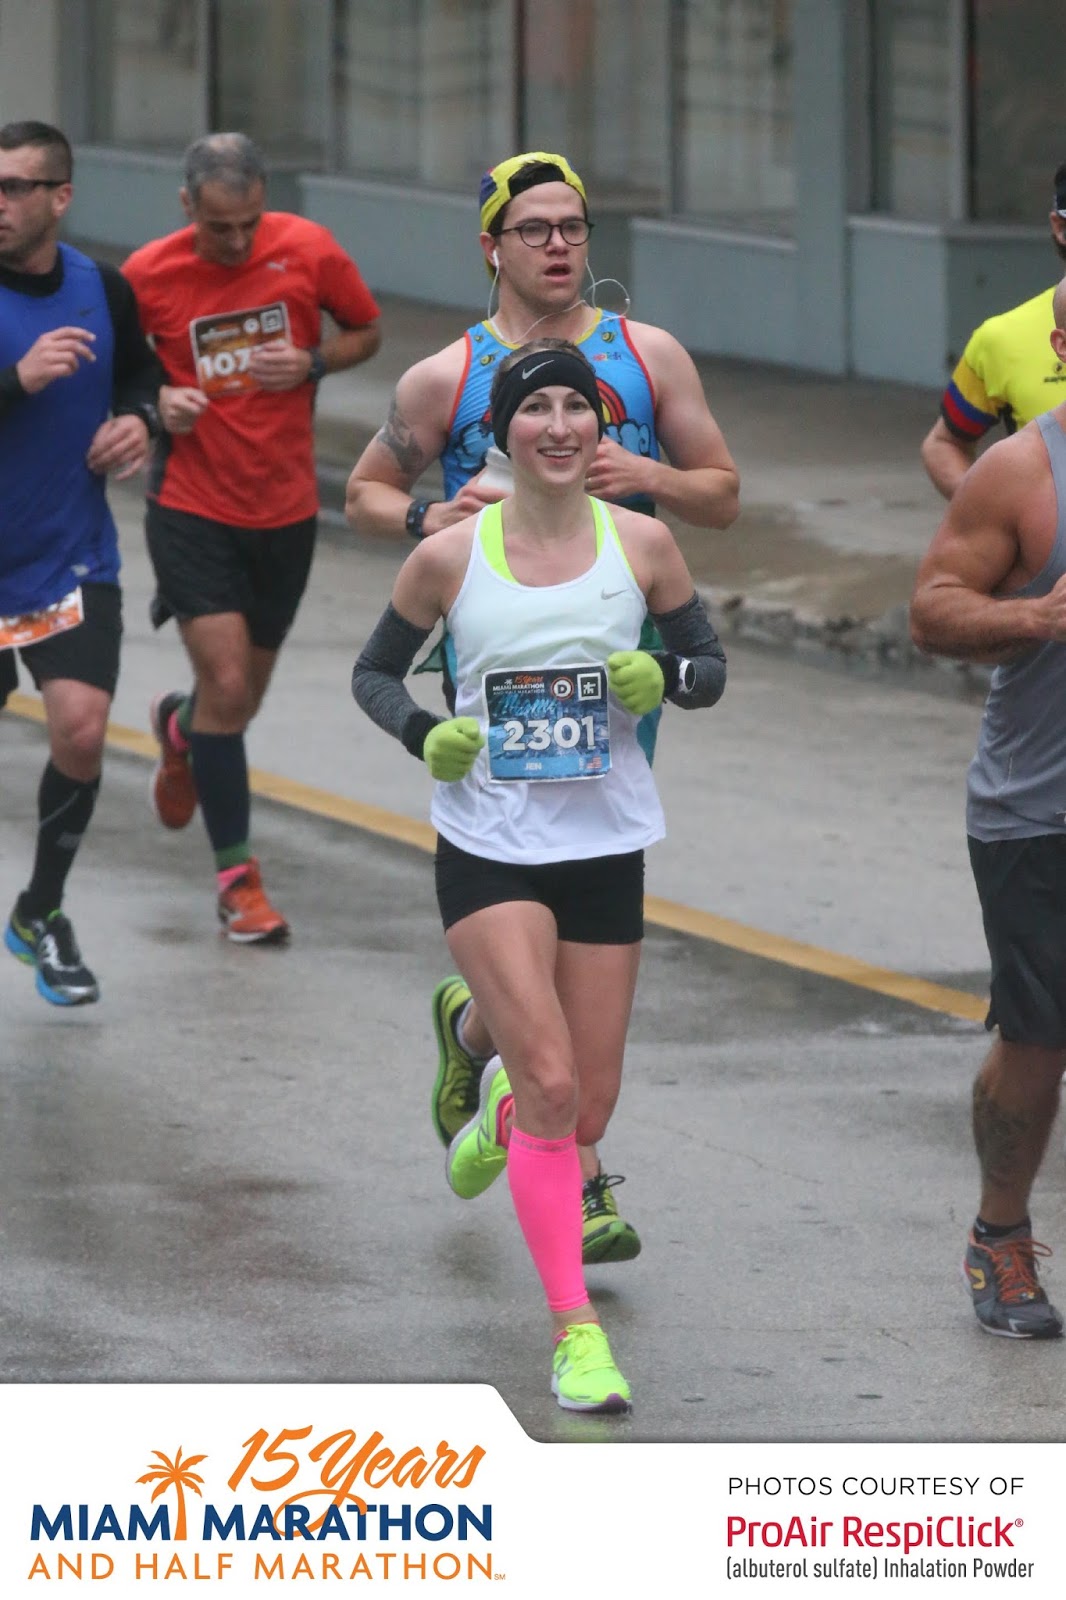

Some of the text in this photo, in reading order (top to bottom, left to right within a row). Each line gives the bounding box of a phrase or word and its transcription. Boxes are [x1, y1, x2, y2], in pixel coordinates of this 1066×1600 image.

[199, 344, 263, 379] 107
[492, 682, 545, 692] MIAMI MARATHON
[503, 715, 596, 751] 2301
[525, 762, 542, 771] JEN
